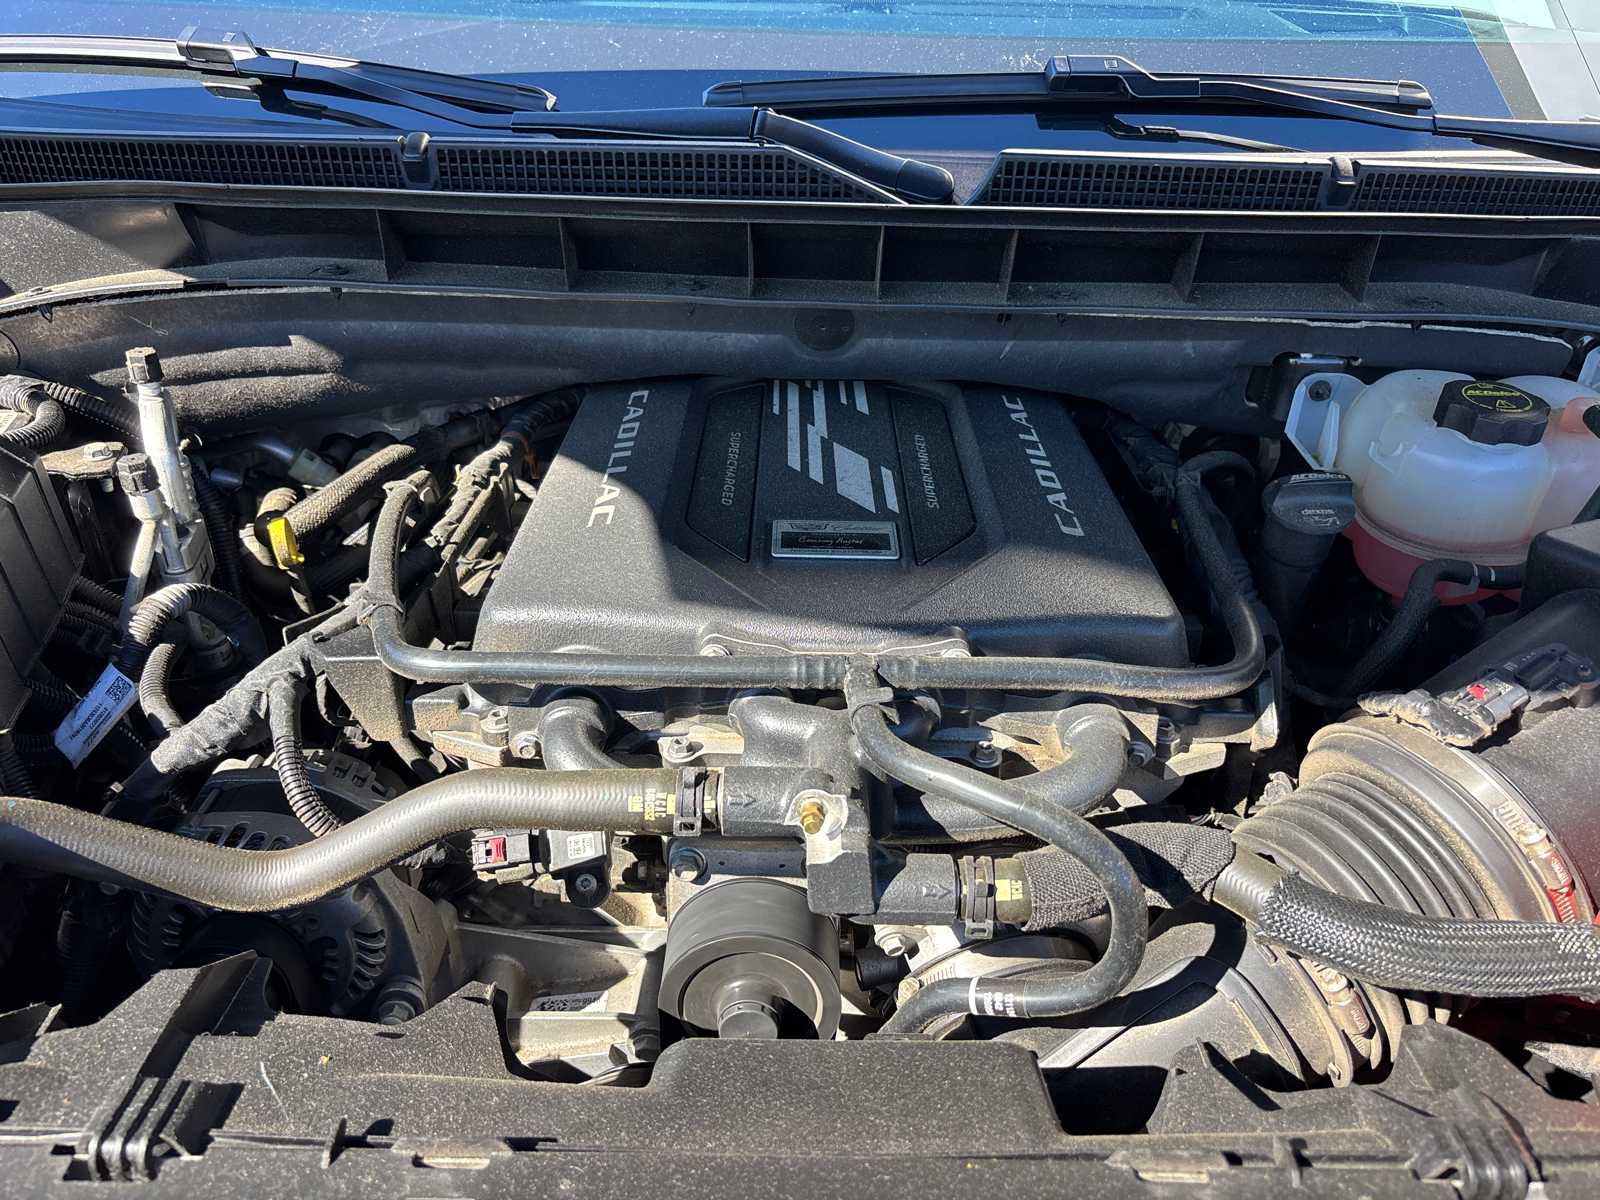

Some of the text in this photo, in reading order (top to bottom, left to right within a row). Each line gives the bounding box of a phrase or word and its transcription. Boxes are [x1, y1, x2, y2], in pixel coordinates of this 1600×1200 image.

[587, 390, 649, 528] CADILLAC
[722, 432, 741, 505] SUPERCHARGED
[915, 435, 939, 508] SUPERCHARGED
[1002, 395, 1085, 536] CADILLAC
[1290, 473, 1346, 483] ACDelco
